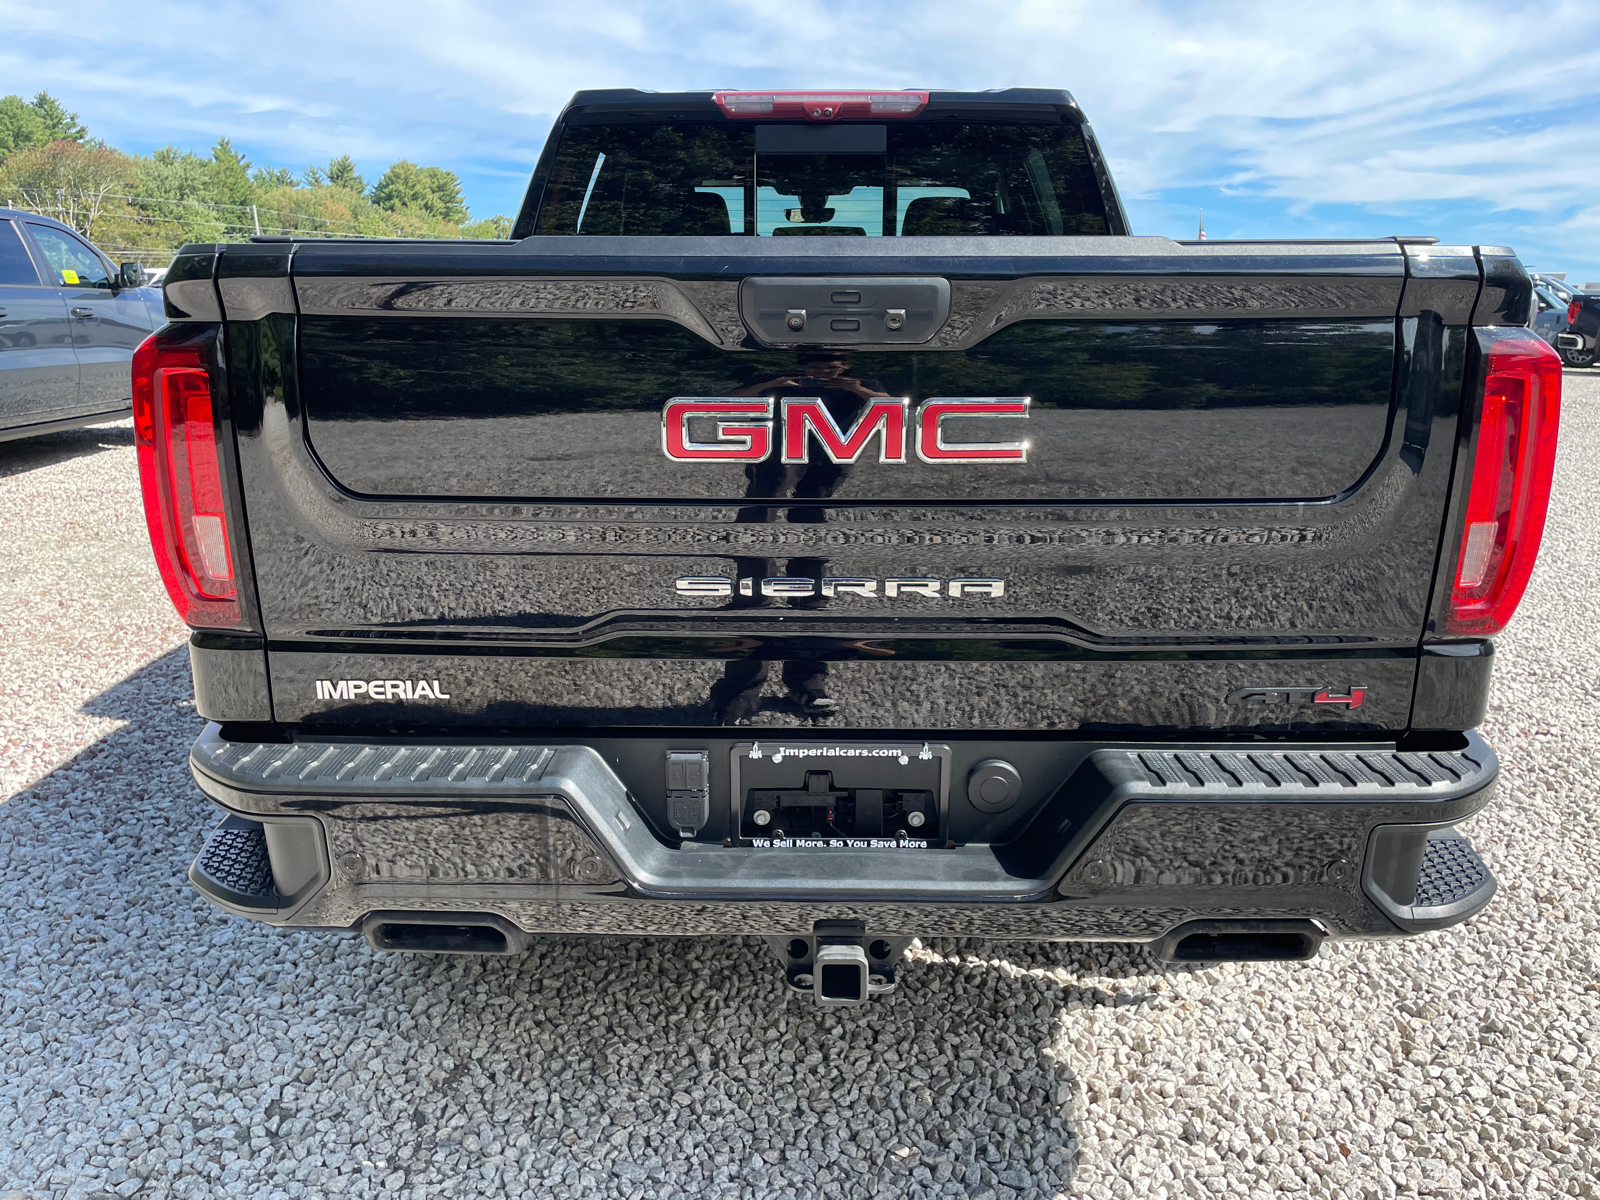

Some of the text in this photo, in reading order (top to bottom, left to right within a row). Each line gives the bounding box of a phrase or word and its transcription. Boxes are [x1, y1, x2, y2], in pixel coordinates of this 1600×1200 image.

[660, 396, 1031, 464] GMC
[675, 576, 1005, 598] SIERRA
[315, 679, 451, 700] IMPERIAL
[1226, 686, 1367, 710] AT4
[778, 746, 902, 758] Imperialcars.com
[752, 839, 770, 848] We
[773, 839, 793, 848] Sell
[829, 839, 844, 848] So
[846, 839, 867, 848] You
[870, 839, 897, 848] Save
[899, 839, 928, 848] More
